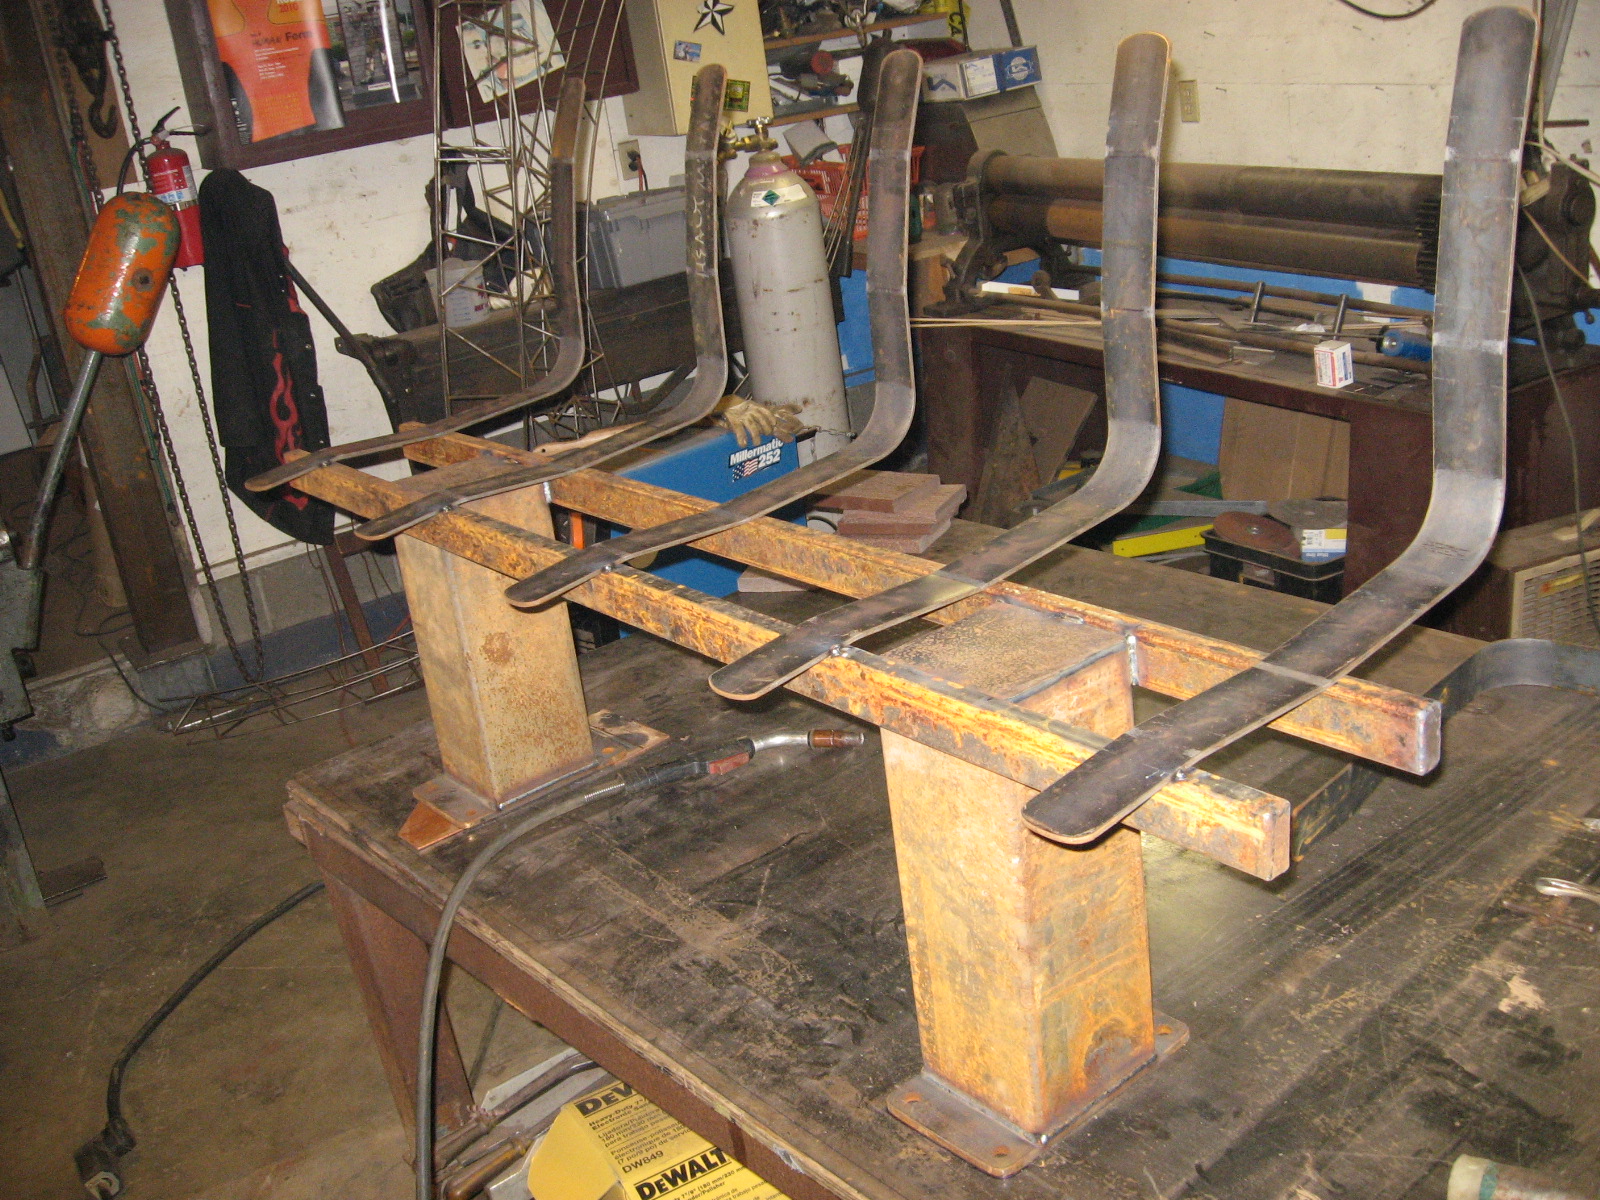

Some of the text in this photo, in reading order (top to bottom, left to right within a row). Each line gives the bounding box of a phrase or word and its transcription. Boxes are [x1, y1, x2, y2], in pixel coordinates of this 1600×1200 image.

[729, 438, 785, 466] Millermatic
[758, 448, 782, 468] 252
[589, 1104, 633, 1127] Heavy-Duty
[591, 1108, 633, 1131] Electronic
[621, 1150, 664, 1174] DW849
